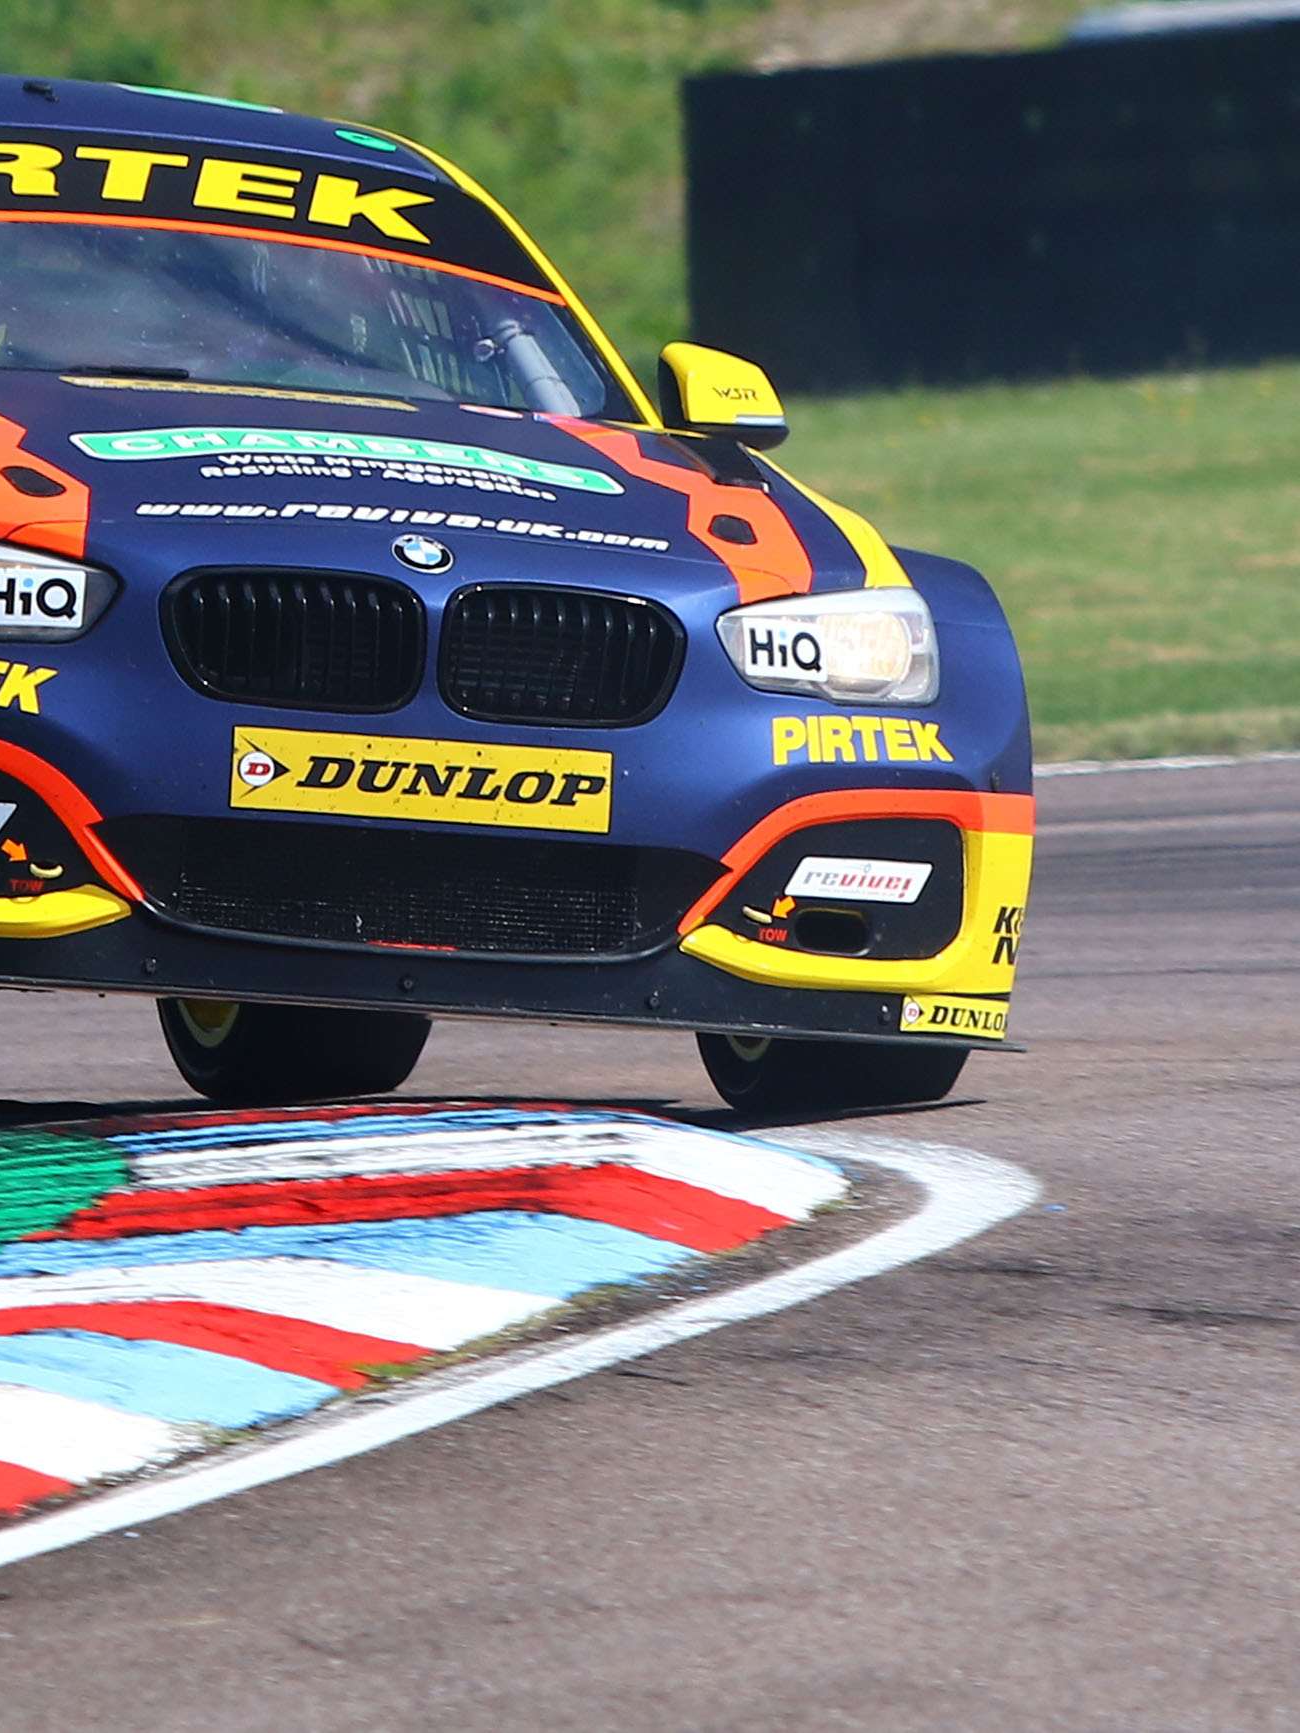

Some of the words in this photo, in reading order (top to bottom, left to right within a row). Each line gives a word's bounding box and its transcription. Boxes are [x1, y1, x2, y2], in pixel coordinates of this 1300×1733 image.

[711, 386, 759, 402] WSR
[200, 464, 353, 479] Recycling
[218, 454, 316, 466] Waste
[323, 455, 522, 486] Management
[135, 503, 670, 552] www.revive-uk.com
[748, 627, 822, 673] HiQ
[771, 715, 955, 765] PIRTEK
[295, 755, 607, 807] DUNLOP
[9, 878, 45, 893] TOW
[757, 927, 788, 942] TOW
[927, 1004, 1009, 1033] DUNLO
